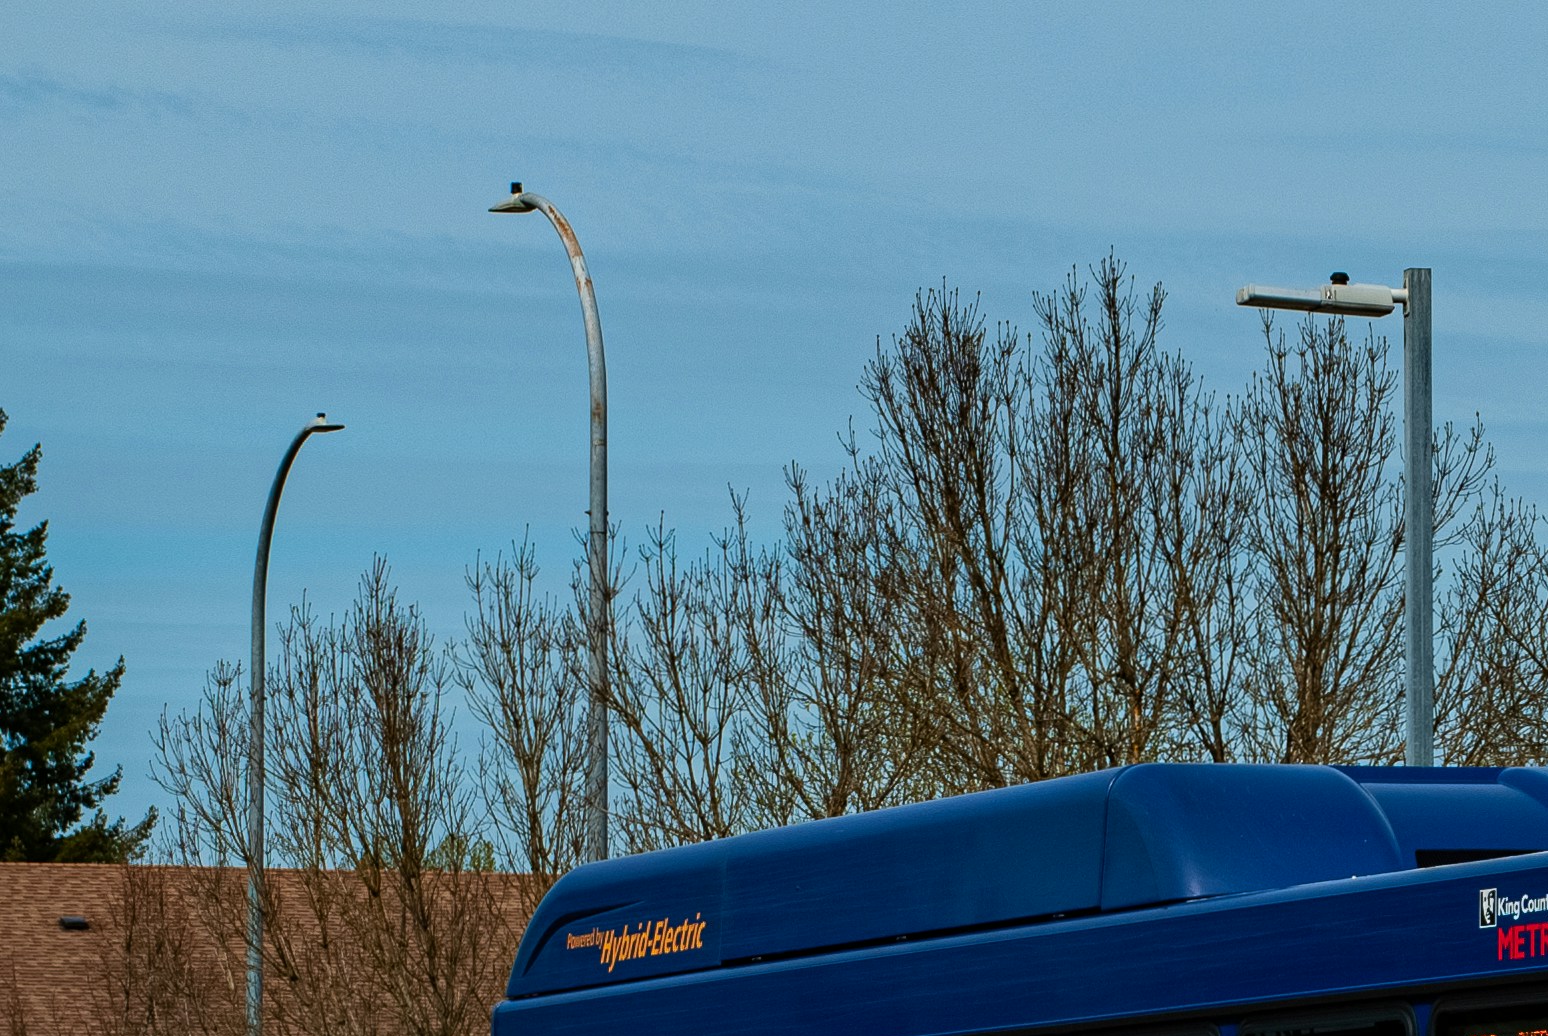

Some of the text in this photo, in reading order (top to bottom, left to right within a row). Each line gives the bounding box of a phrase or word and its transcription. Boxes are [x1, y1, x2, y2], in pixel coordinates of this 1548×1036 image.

[1497, 896, 1520, 920] King
[595, 926, 605, 950] by
[600, 912, 706, 973] Hybrid-Electric
